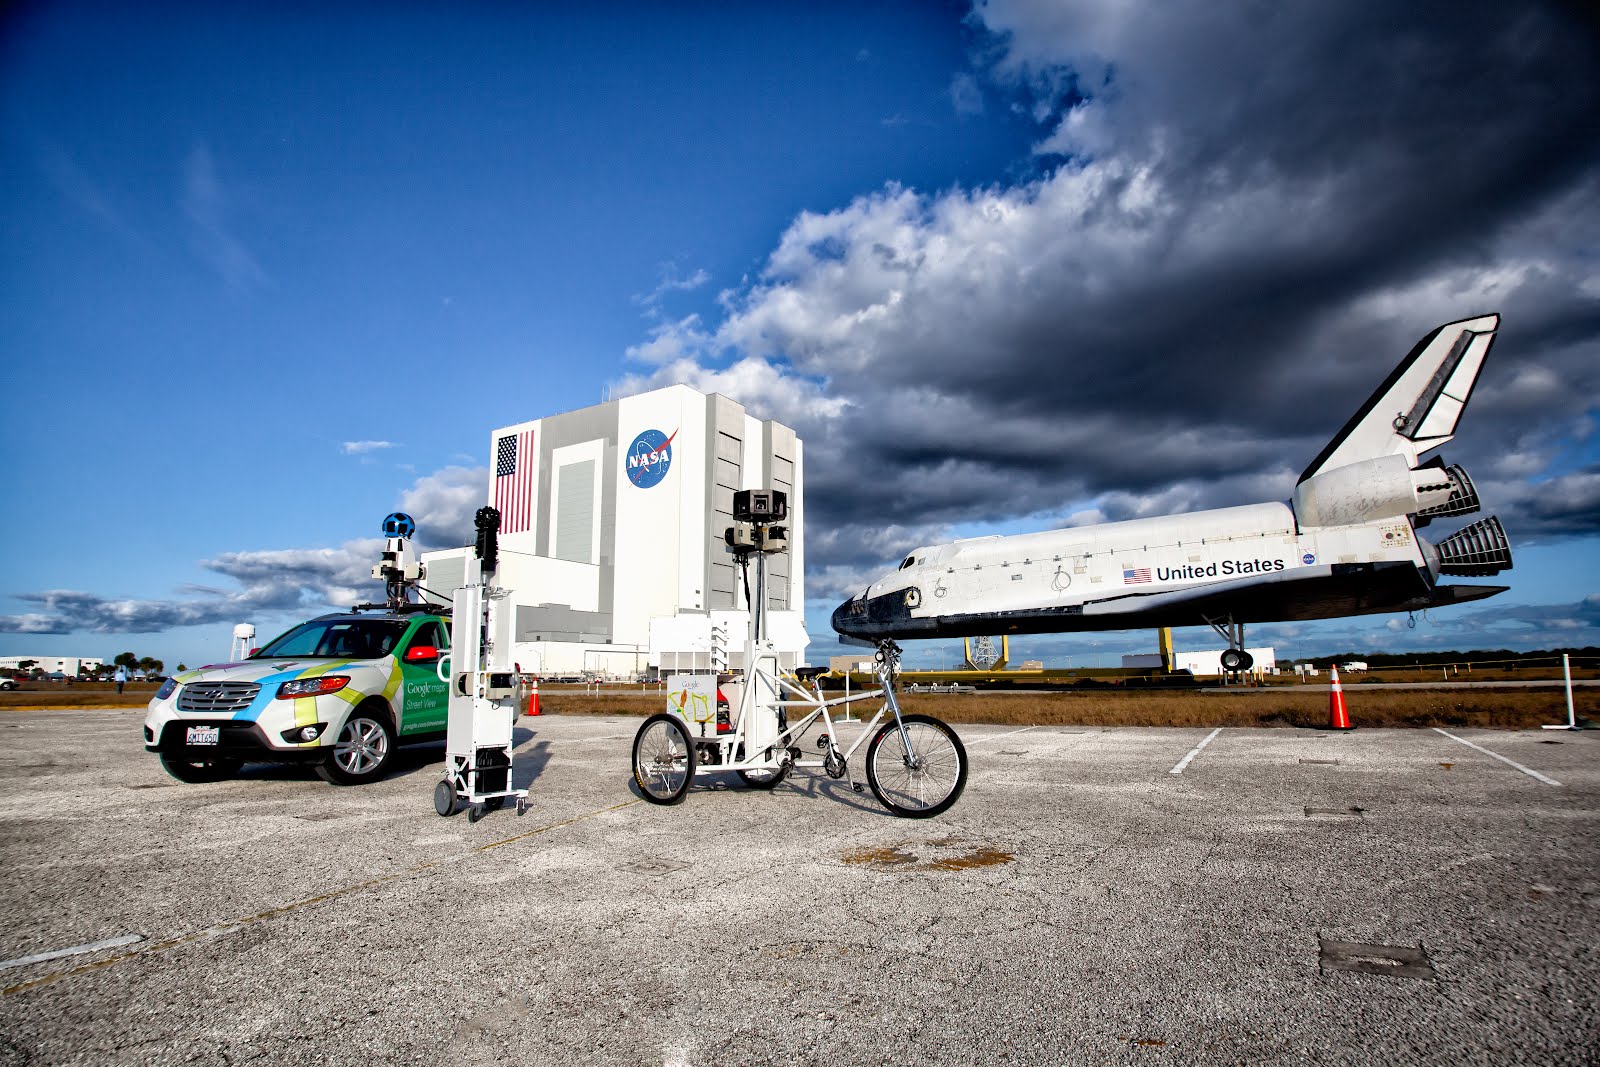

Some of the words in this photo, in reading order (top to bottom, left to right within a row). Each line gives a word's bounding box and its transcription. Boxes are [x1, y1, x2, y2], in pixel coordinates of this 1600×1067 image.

[629, 449, 670, 469] NASA
[1157, 562, 1217, 581] United
[1221, 558, 1285, 575] States
[407, 682, 430, 697] Google
[432, 684, 446, 694] maps
[682, 680, 699, 690] Google
[406, 699, 423, 710] Street
[424, 699, 437, 709] View
[188, 733, 218, 743] 6MIT650
